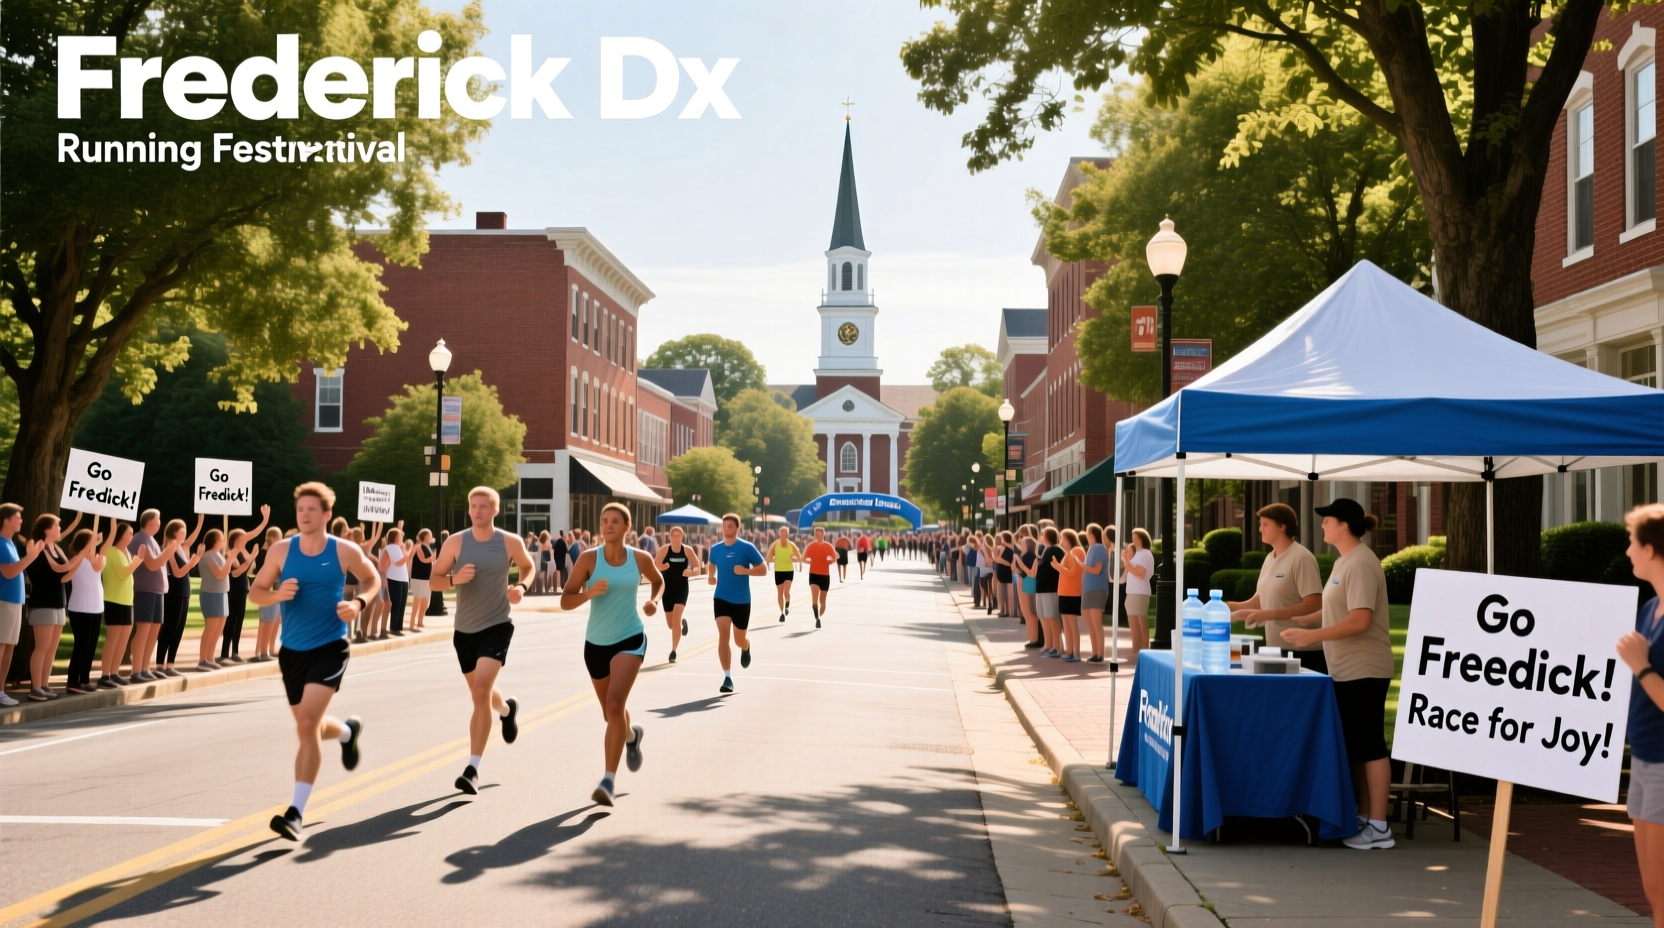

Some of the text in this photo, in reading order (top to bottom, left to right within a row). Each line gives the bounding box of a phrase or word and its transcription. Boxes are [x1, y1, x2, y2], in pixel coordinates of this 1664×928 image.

[87, 461, 112, 481] Go
[210, 468, 229, 483] Go
[68, 480, 137, 510] Fredick!
[199, 486, 249, 503] Fredick!
[1476, 593, 1536, 637] Go
[1418, 635, 1617, 702] Freedick!
[1407, 692, 1614, 767] Race for Joy!
